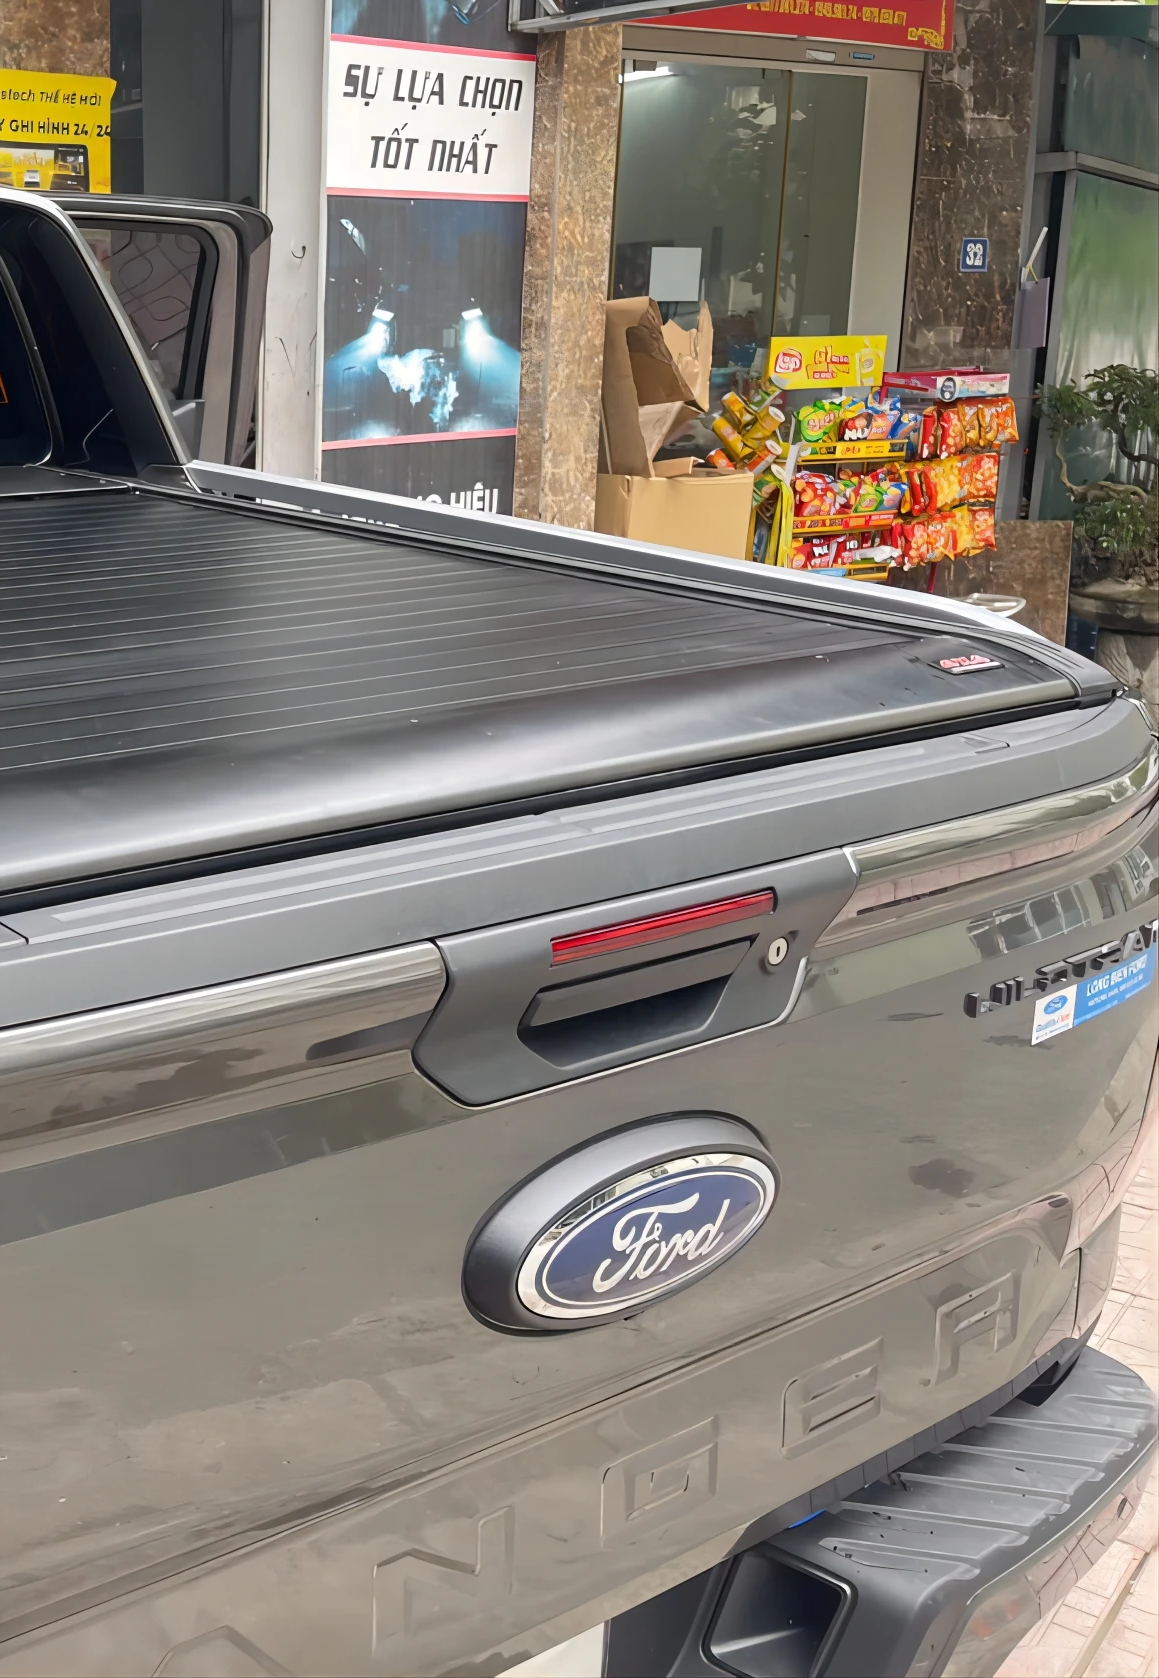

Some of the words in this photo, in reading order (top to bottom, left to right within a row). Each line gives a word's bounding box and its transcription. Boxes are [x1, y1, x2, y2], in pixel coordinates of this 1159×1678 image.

[343, 63, 384, 107] SỰ
[392, 68, 445, 110] LỰA
[458, 75, 524, 116] CHỌN
[9, 119, 34, 133] GHI
[370, 122, 420, 171] TỐT
[427, 128, 499, 175] NHẤT
[592, 1192, 731, 1294] Ford
